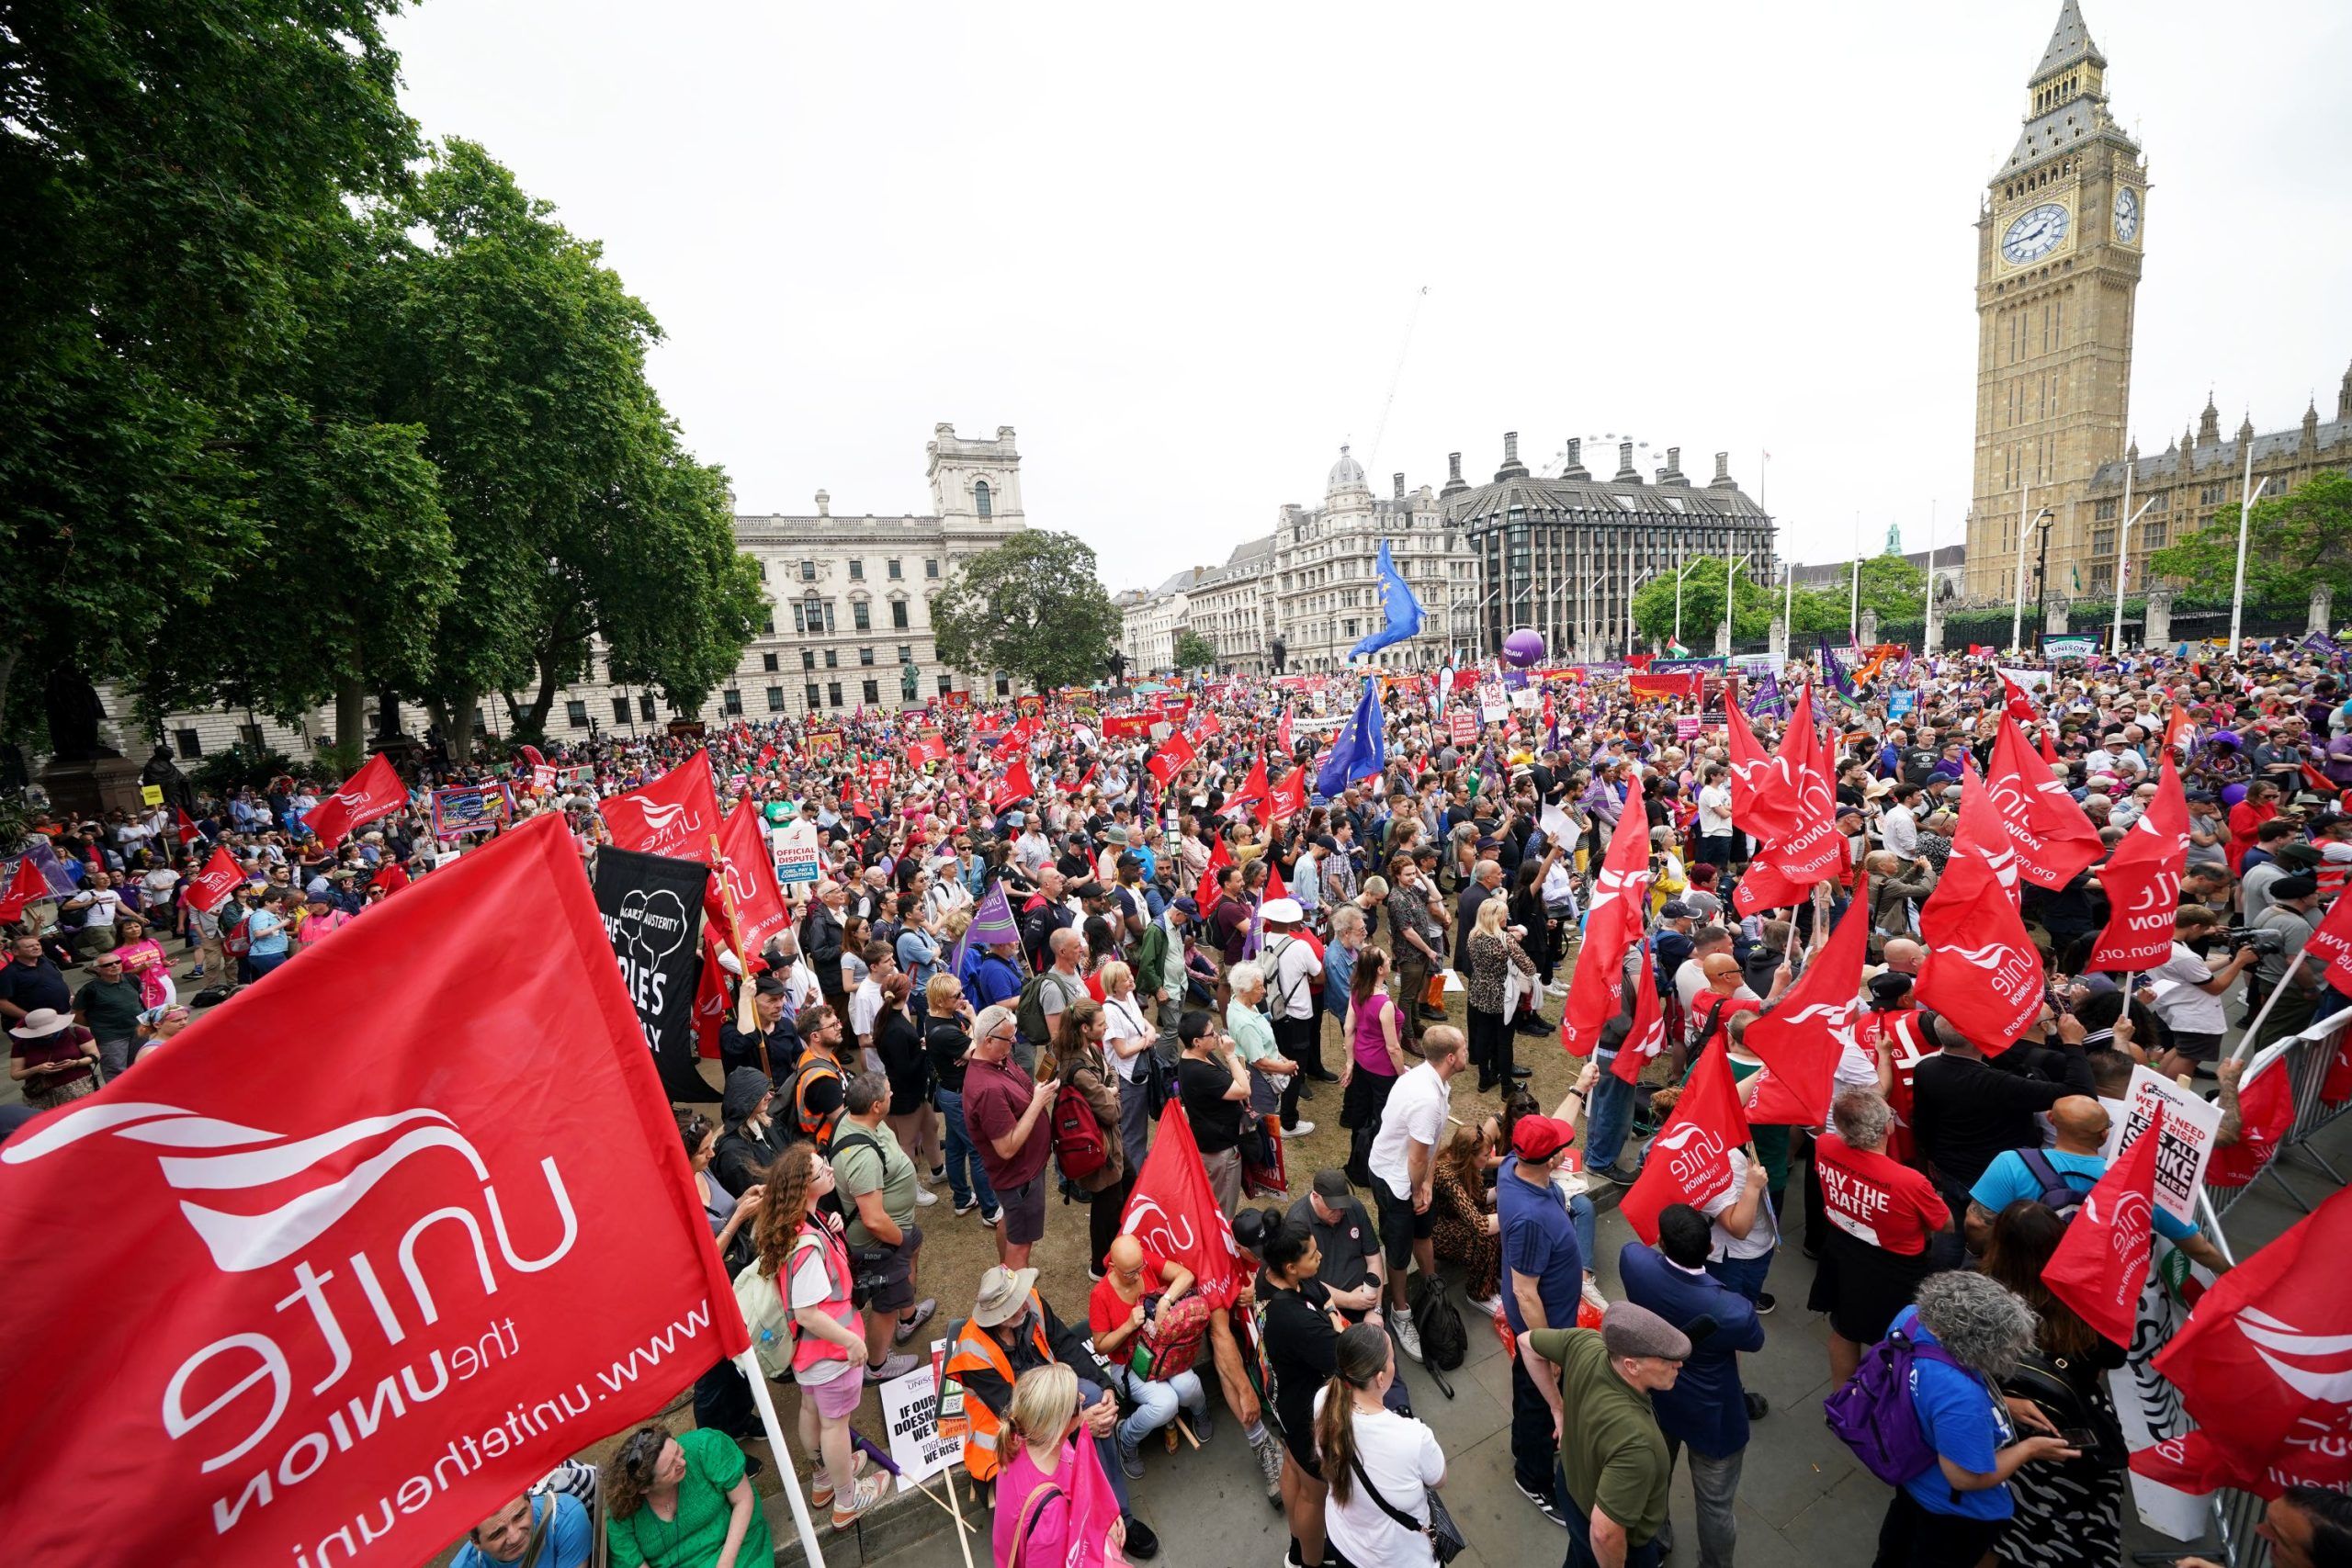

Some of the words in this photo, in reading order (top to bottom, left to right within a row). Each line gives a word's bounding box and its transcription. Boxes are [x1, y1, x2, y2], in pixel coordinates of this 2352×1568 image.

[2052, 645, 2087, 653] UNISON
[1485, 683, 1501, 694] EAT
[1121, 720, 1148, 728] KNOWSLEY
[479, 779, 498, 790] MAKE
[484, 792, 497, 801] PAY
[776, 847, 816, 856] OFFICIAL
[778, 854, 815, 863] DISPUTE
[643, 913, 680, 932] AUSTERITY
[2153, 1084, 2184, 1107] Socialist
[2135, 1092, 2154, 1110] WE
[2176, 1115, 2206, 1142] NEED
[2136, 1107, 2145, 1118] A
[2168, 1124, 2199, 1147] RISE!
[2172, 1139, 2198, 1165] ALL
[1819, 1161, 1849, 1190] PAY
[1852, 1179, 1891, 1213] THE
[1828, 1184, 1872, 1222] RATE
[899, 1404, 911, 1420] IF
[912, 1394, 937, 1413] OUR
[912, 1425, 931, 1443] WE
[924, 1451, 941, 1465] WE
[939, 1440, 961, 1456] RISE
